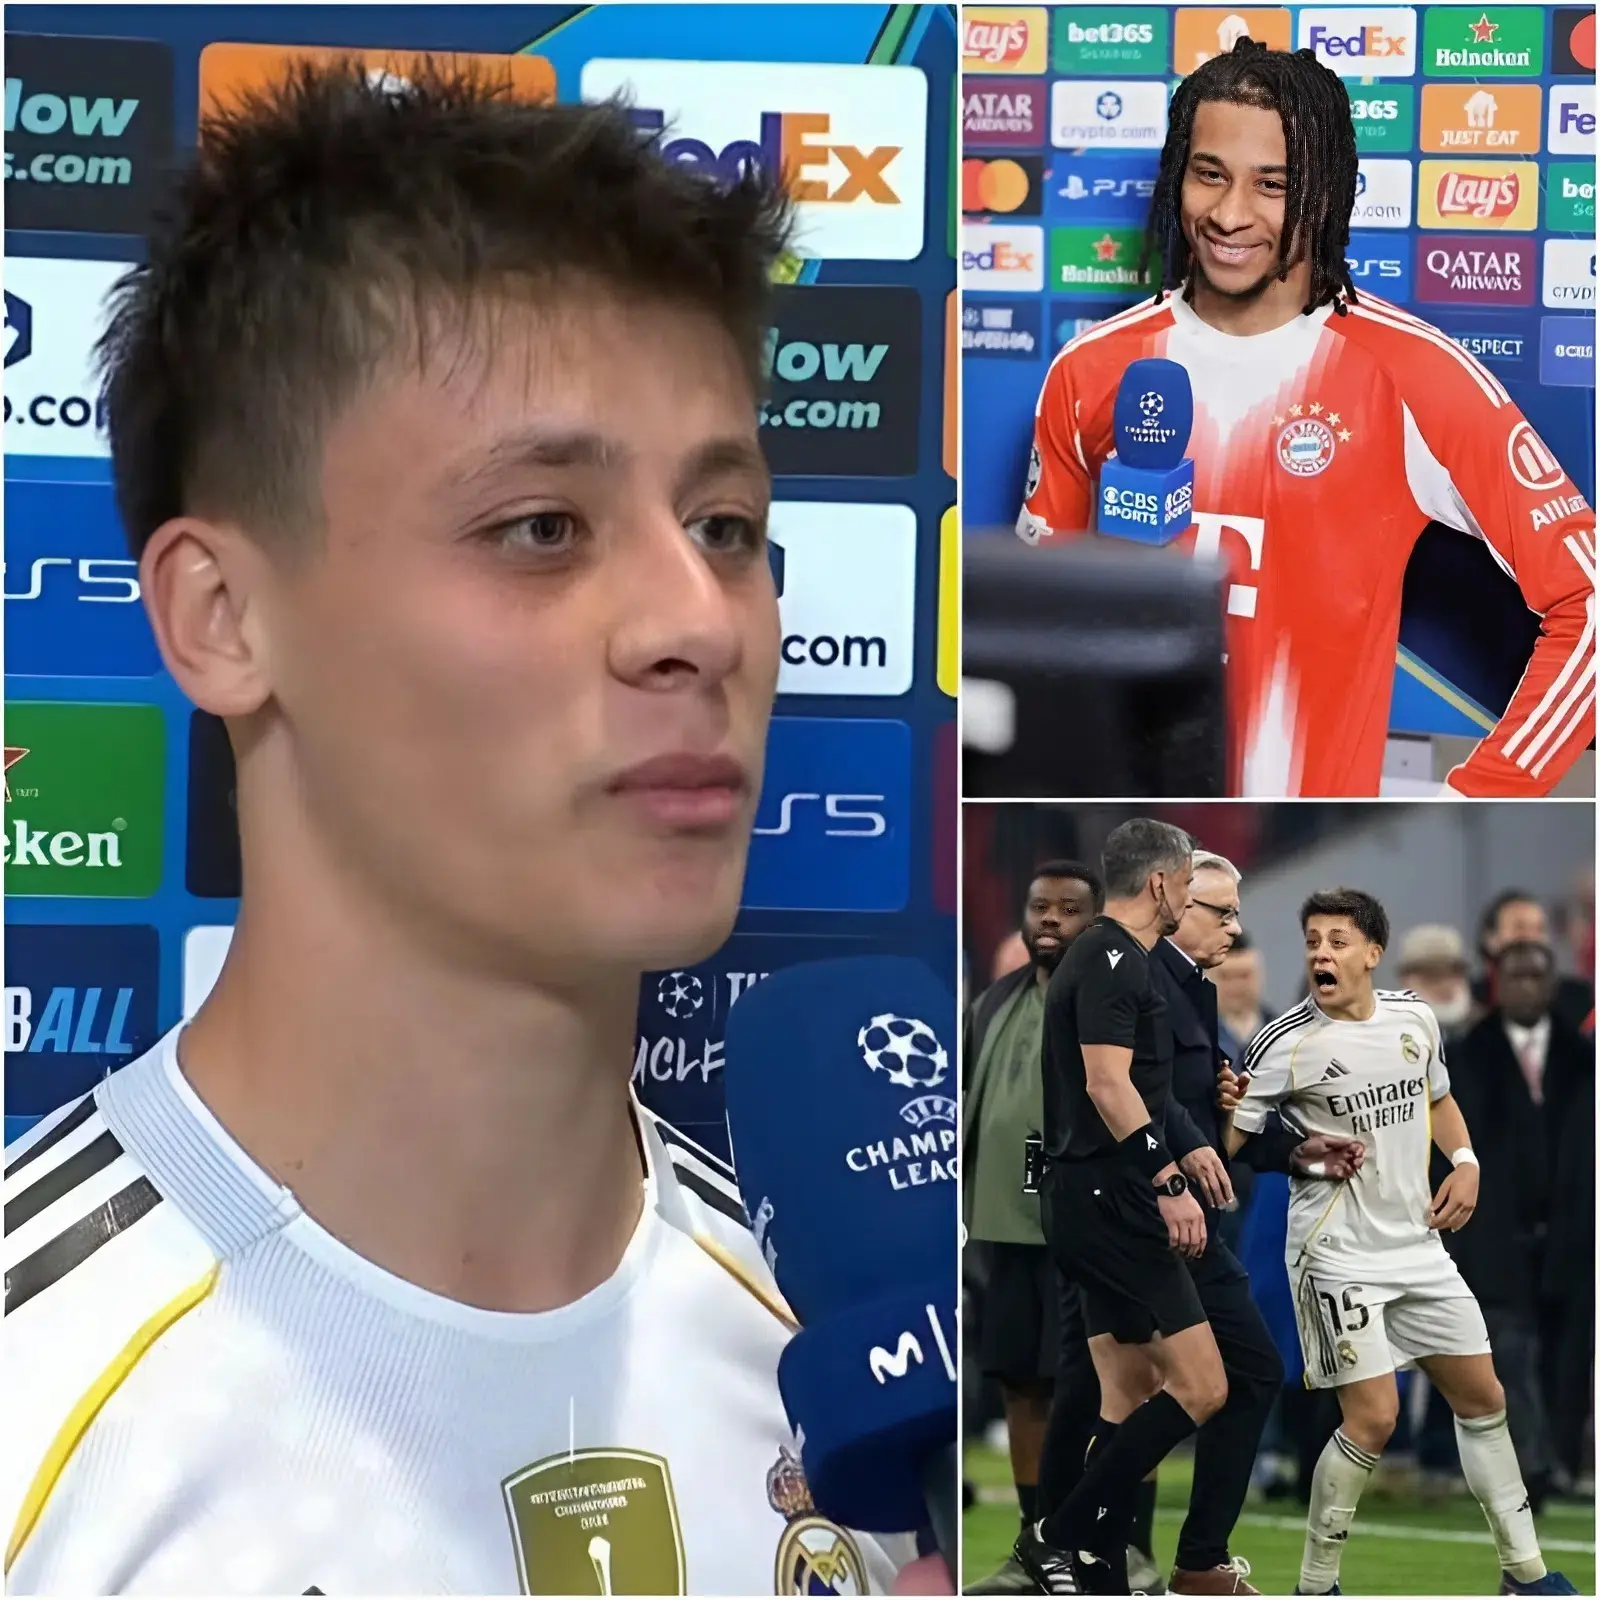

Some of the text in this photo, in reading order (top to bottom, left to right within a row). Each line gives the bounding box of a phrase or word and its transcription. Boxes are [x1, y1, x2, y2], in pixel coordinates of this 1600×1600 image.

[1068, 22, 1153, 43] bet365
[1309, 26, 1405, 57] FedEx
[962, 93, 1033, 117] ATAR
[1440, 130, 1482, 147] JUST
[1093, 178, 1156, 198] PS5
[1427, 250, 1521, 278] QATAR
[1451, 275, 1521, 290] AIRWAYS
[1120, 490, 1158, 513] CBS
[1104, 503, 1158, 526] SPORTS
[781, 635, 887, 668] com
[4, 819, 123, 867] ken
[4, 986, 134, 1054] BALL
